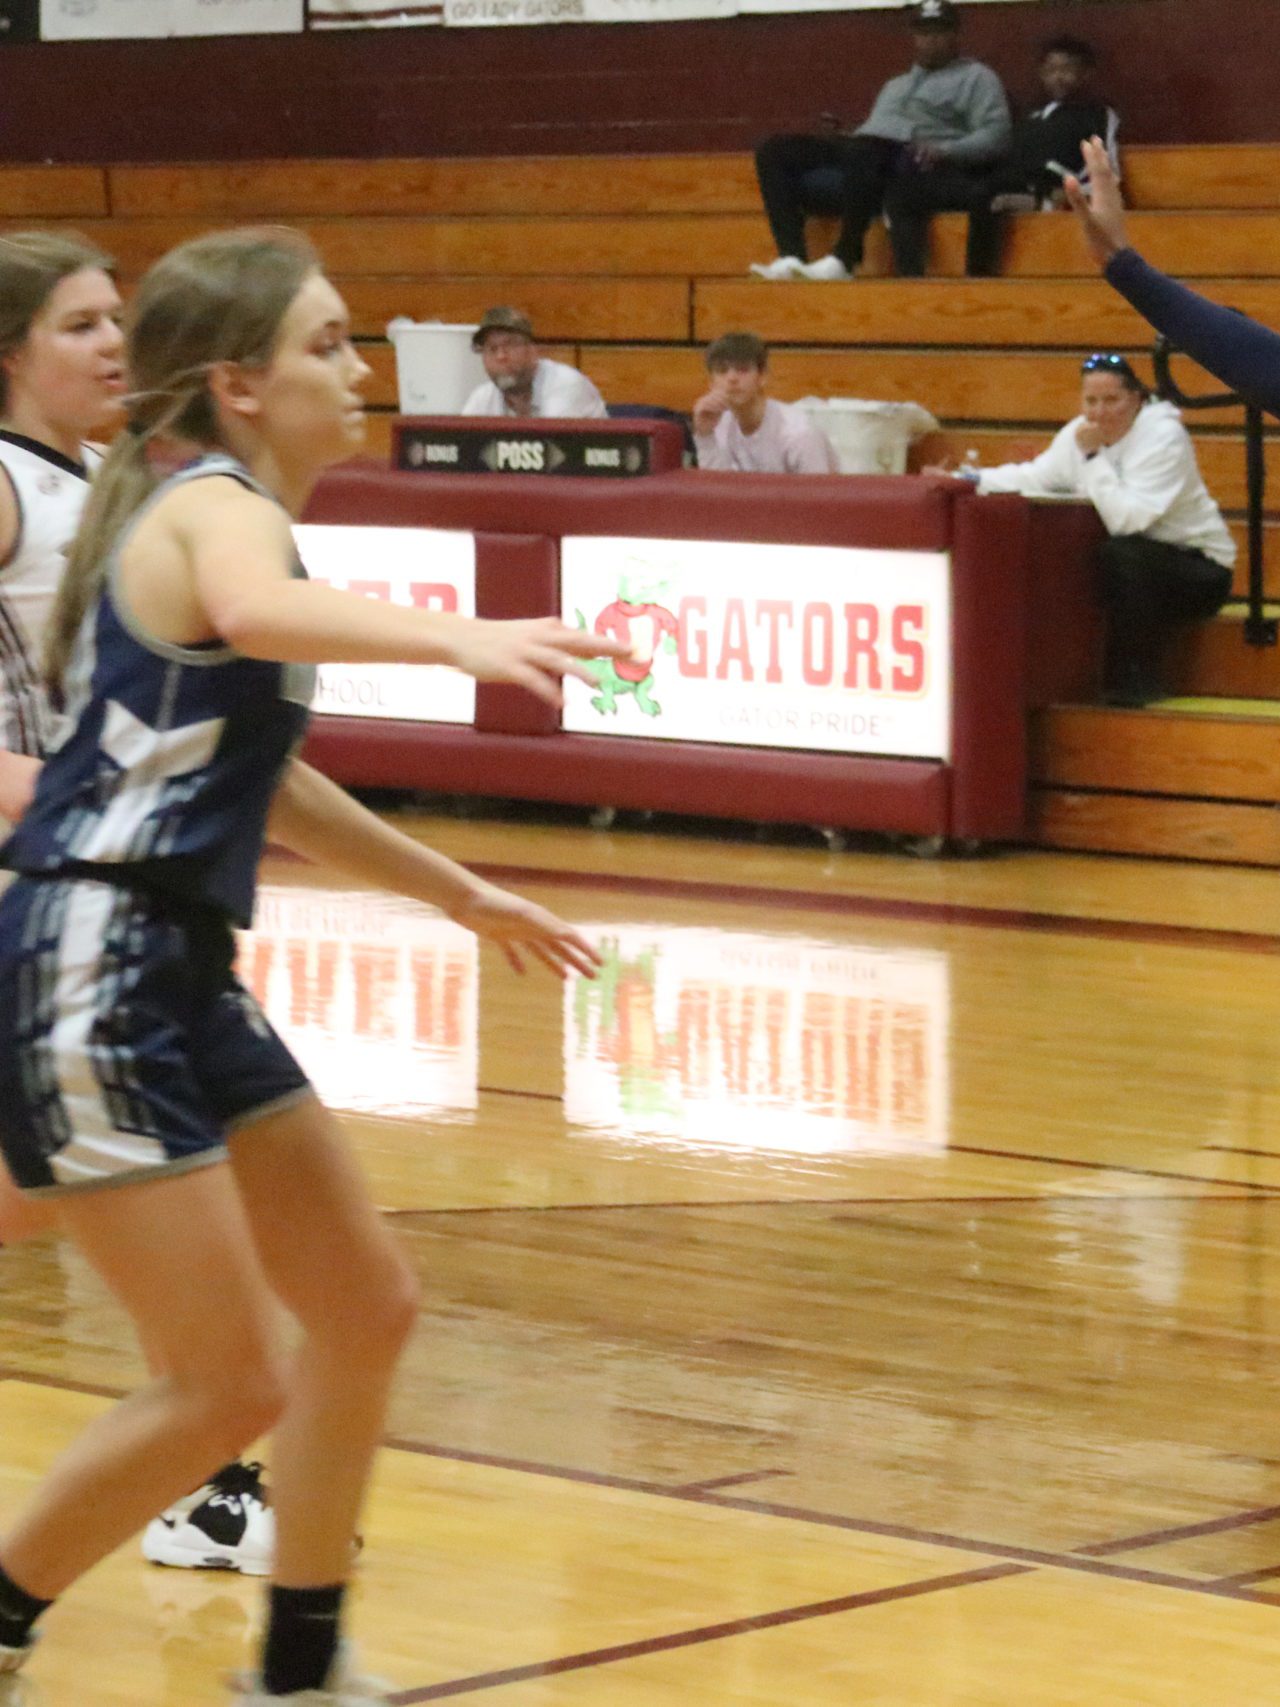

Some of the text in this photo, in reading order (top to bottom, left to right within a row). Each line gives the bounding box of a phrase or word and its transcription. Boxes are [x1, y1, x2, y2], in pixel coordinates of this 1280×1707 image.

[497, 441, 544, 470] POSS
[678, 595, 925, 692] GATORS
[318, 676, 386, 706] HOOL
[719, 705, 800, 729] GATOR
